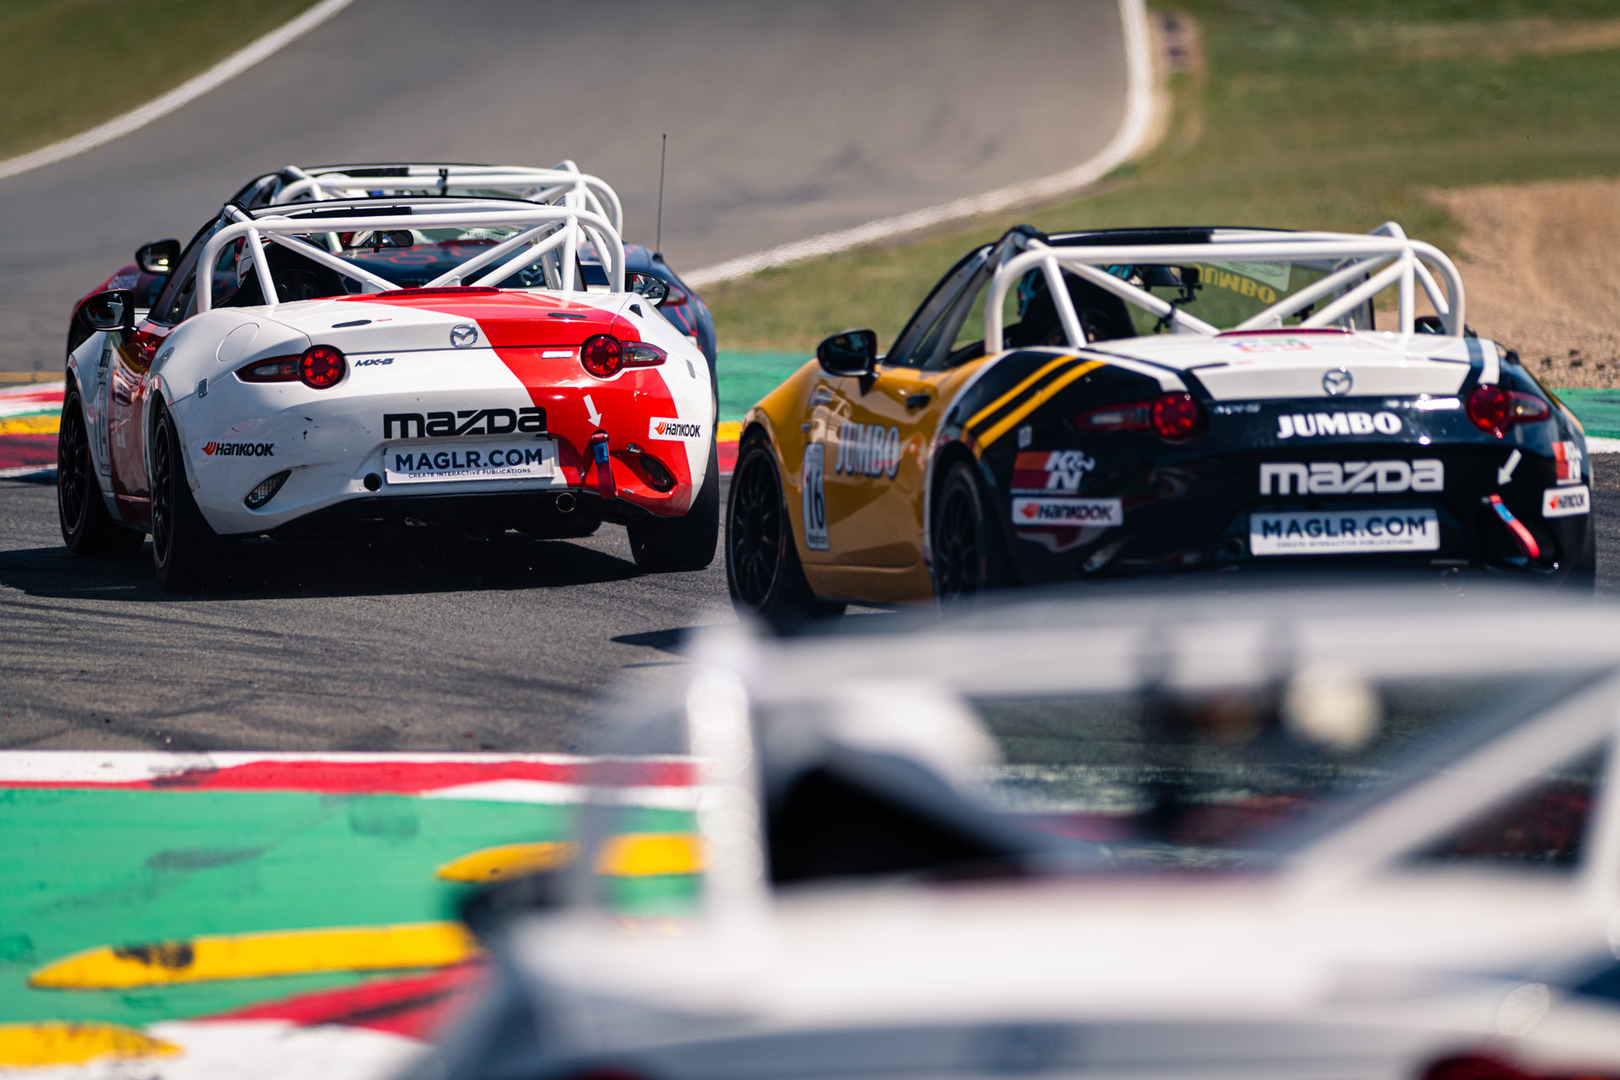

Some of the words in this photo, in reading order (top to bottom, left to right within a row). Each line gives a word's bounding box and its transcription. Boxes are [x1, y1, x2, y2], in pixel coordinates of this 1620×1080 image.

[1277, 411, 1402, 439] JUMBO
[396, 449, 542, 471] MAGLR.COM
[836, 422, 900, 480] JUMBO
[437, 469, 481, 477] INTERACTIVE
[809, 470, 825, 530] 16
[1262, 516, 1426, 539] MAGLR.COM
